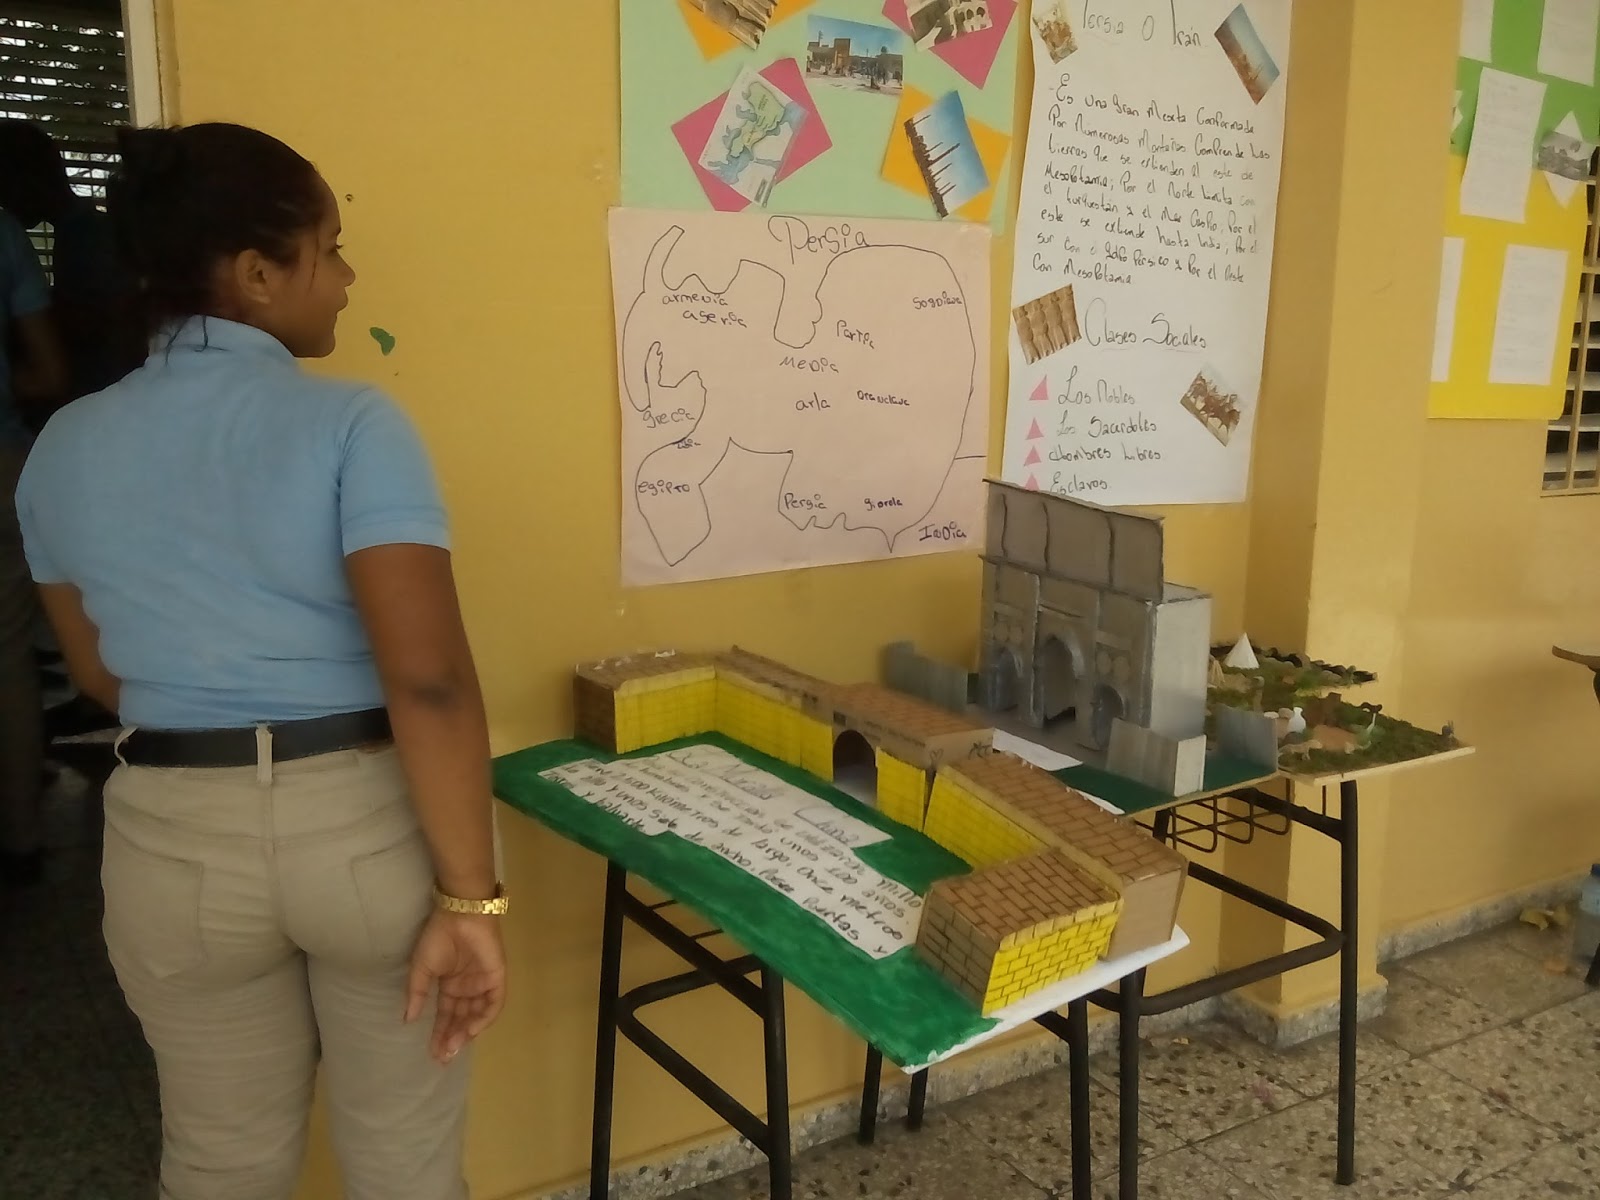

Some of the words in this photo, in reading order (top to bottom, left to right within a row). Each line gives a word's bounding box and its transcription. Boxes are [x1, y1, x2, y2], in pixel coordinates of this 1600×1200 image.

[767, 215, 869, 264] Persia
[1085, 297, 1137, 346] Clases
[1143, 312, 1206, 348] Sociales
[1058, 365, 1092, 404] Los
